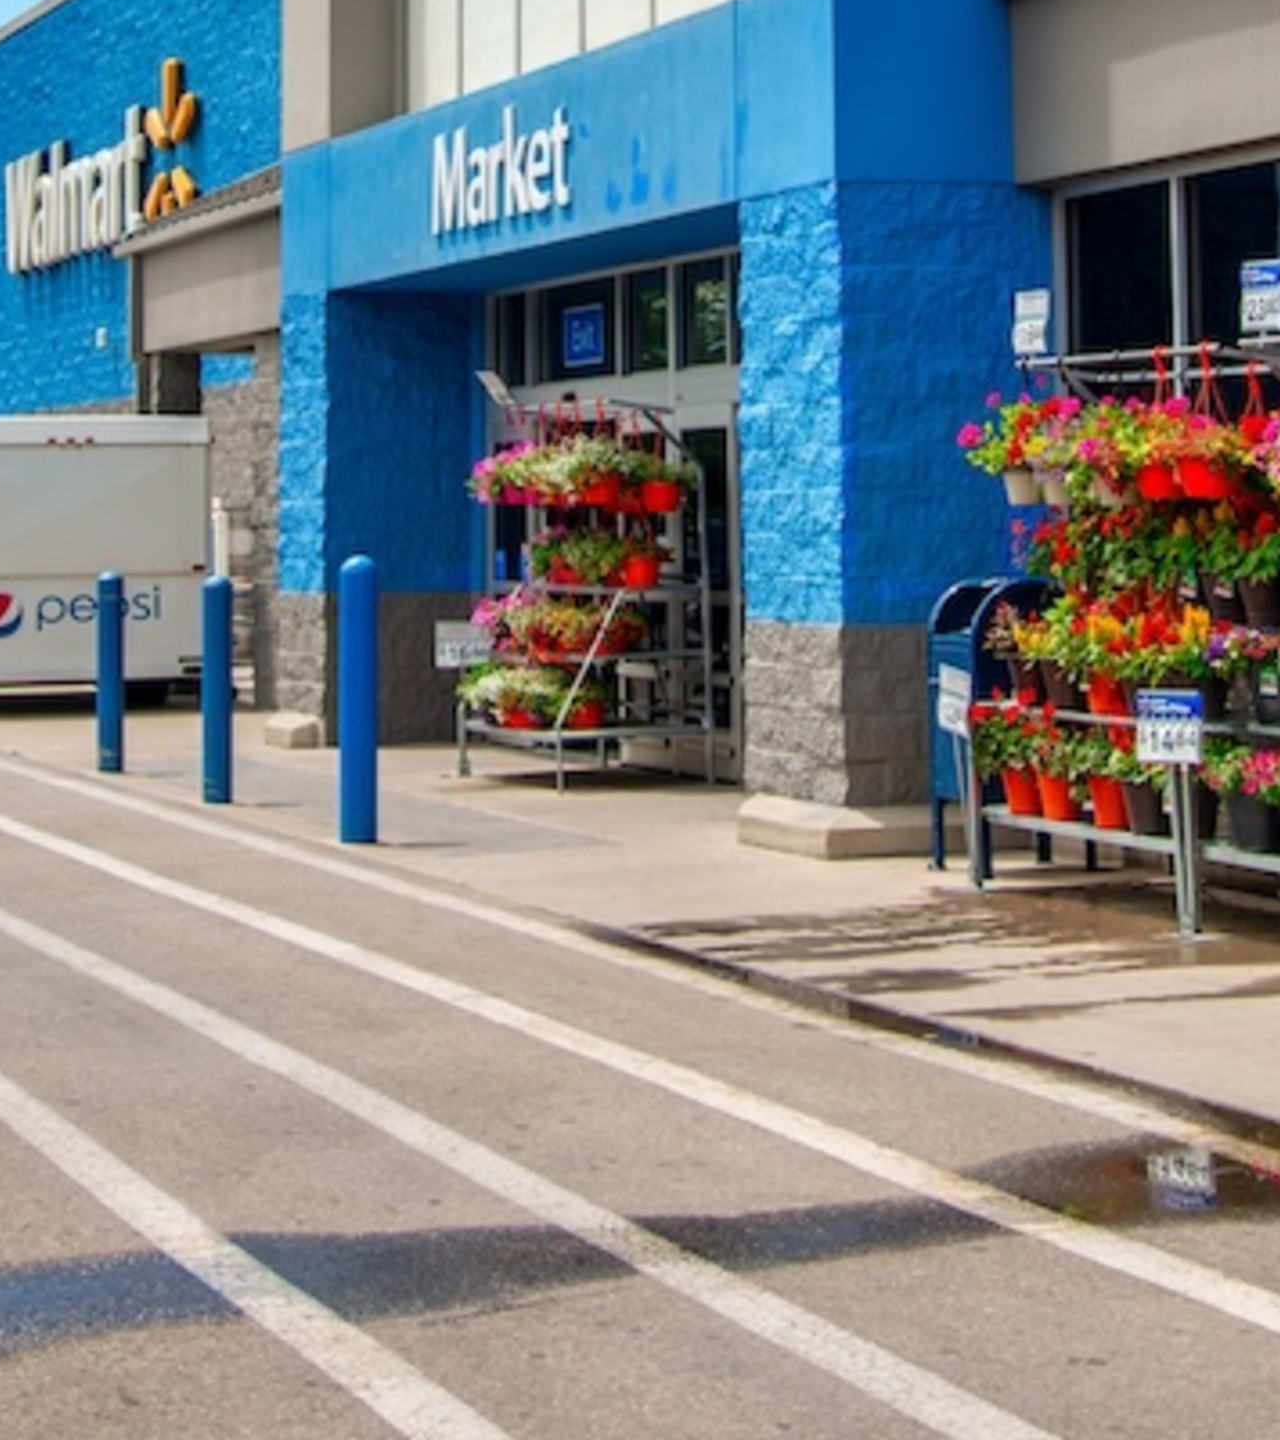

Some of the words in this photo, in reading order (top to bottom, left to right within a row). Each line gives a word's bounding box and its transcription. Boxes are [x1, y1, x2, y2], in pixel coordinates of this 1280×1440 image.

[6, 103, 146, 274] Walmart
[430, 104, 570, 236] Market
[37, 585, 161, 632] pesi
